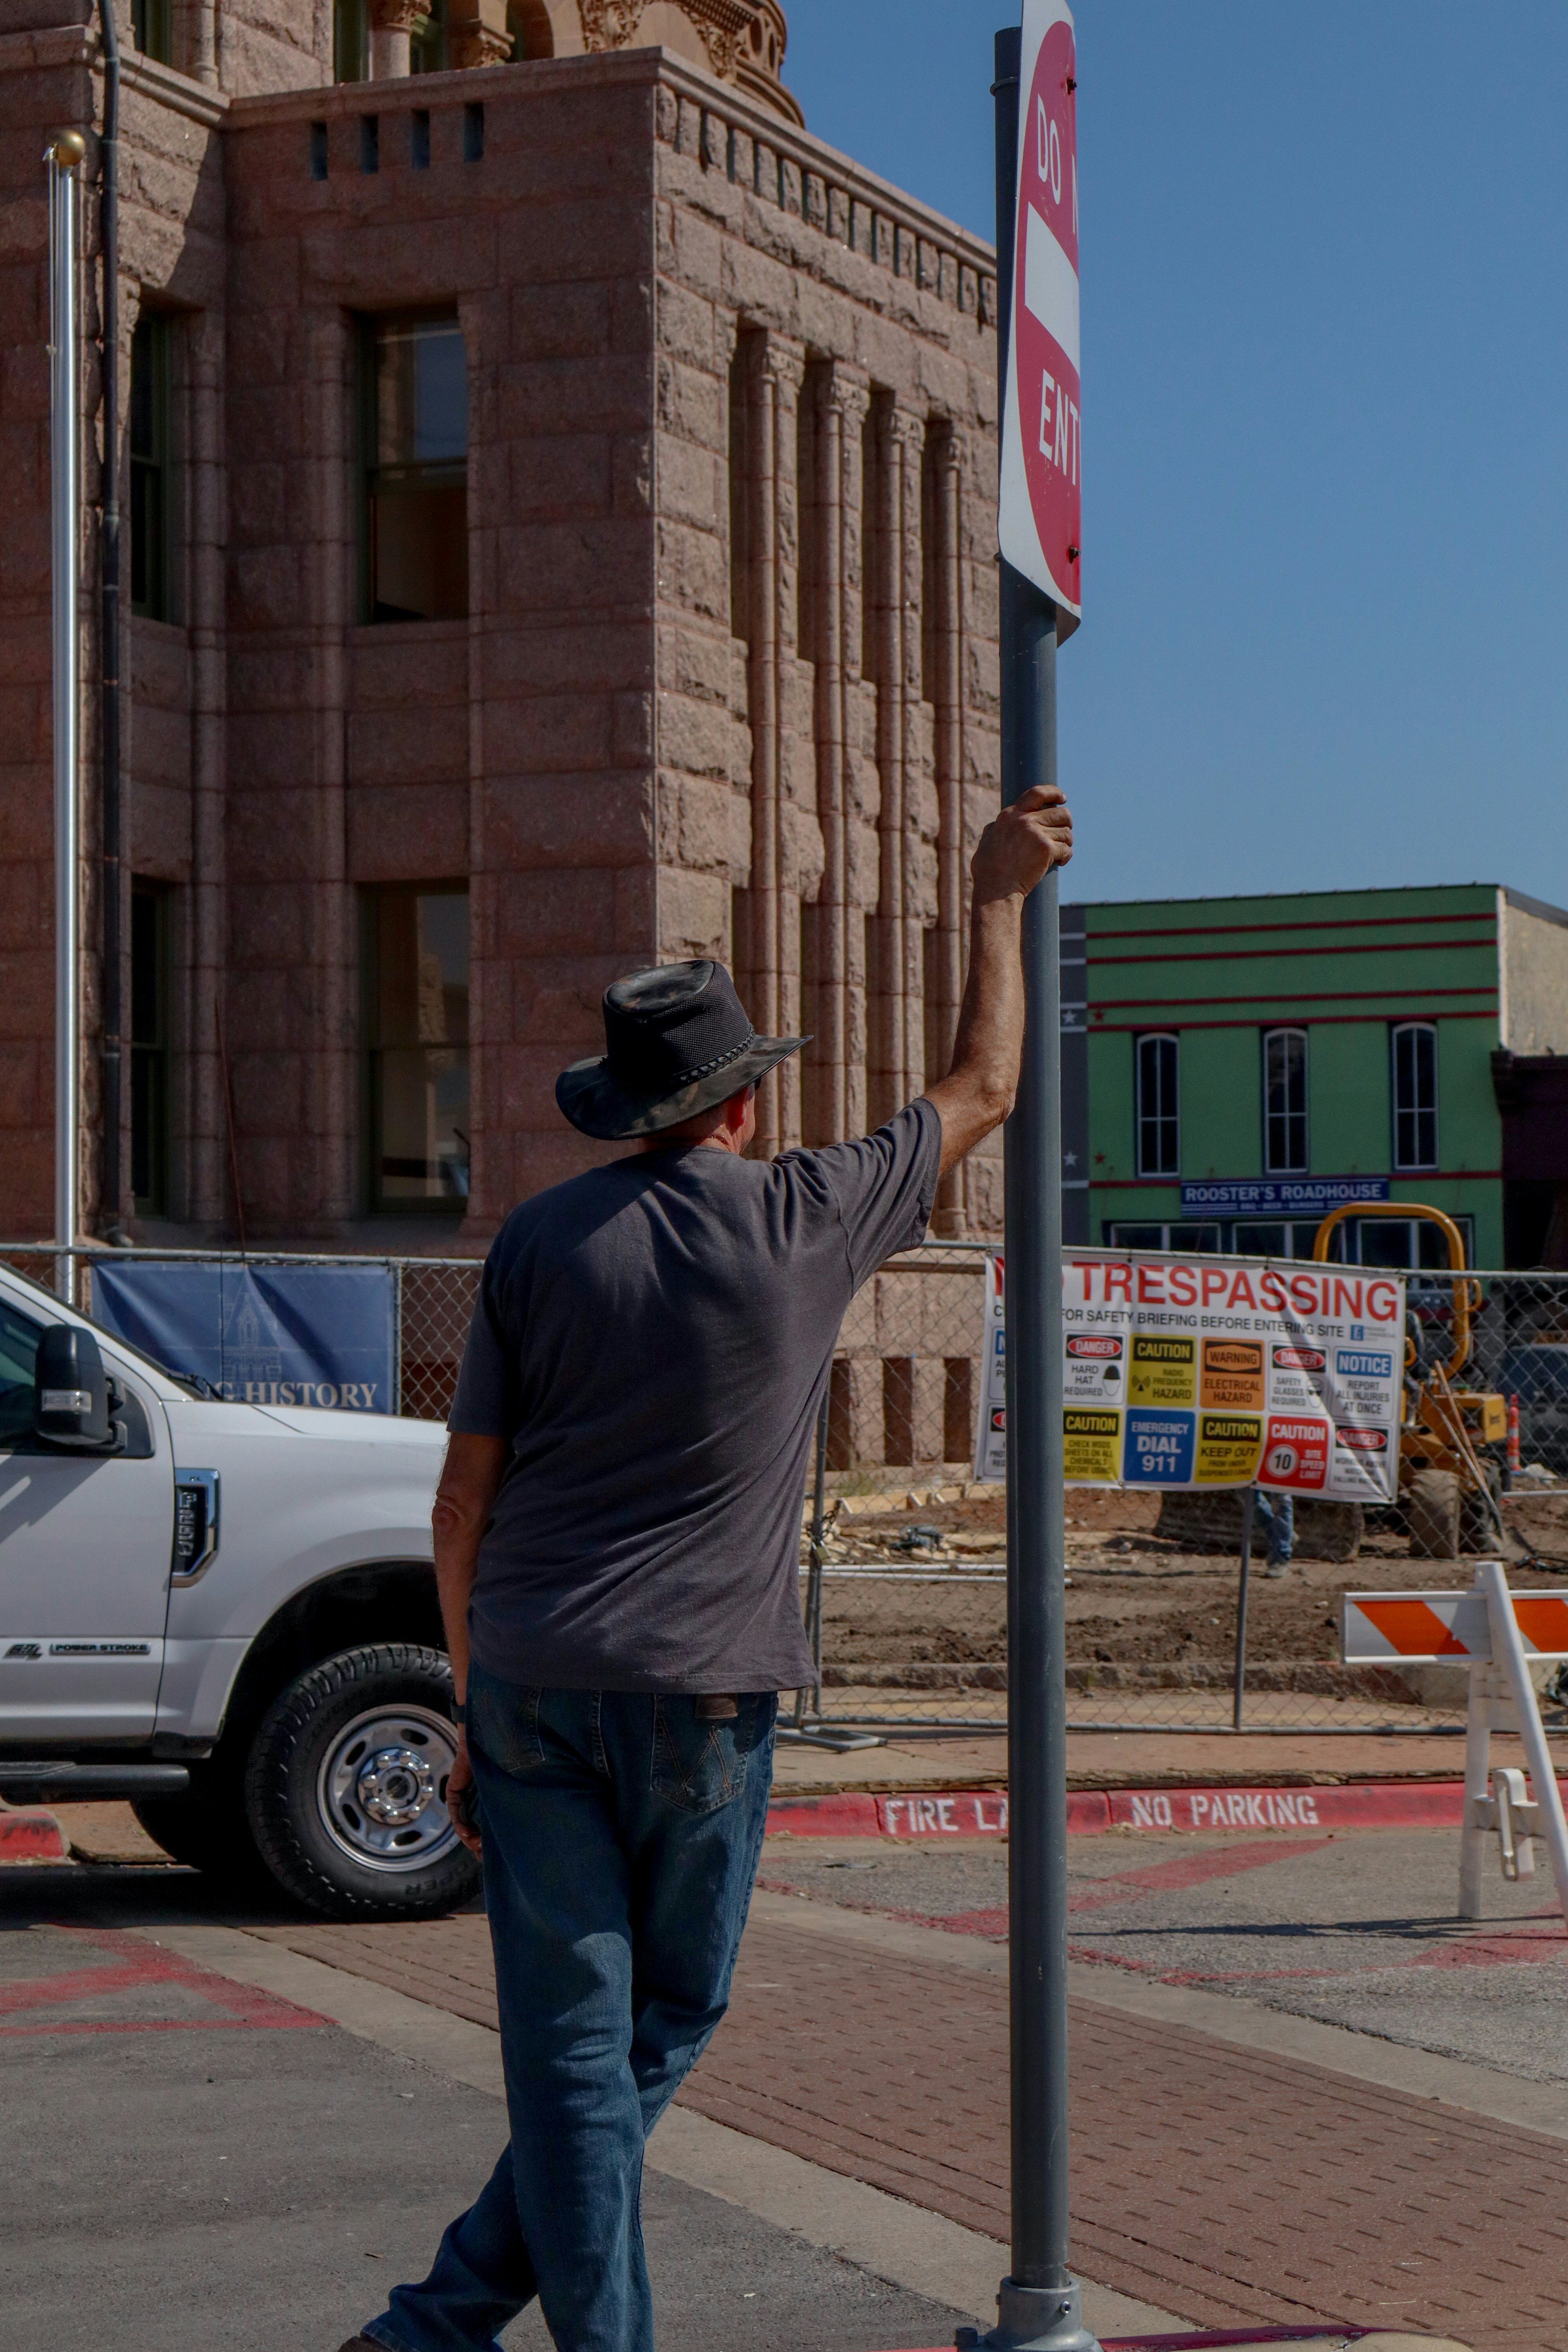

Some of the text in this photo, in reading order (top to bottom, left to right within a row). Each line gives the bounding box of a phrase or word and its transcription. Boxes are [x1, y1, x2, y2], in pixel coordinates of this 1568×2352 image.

[1038, 93, 1061, 205] DO
[1039, 368, 1080, 486] ENT
[1185, 1184, 1382, 1201] ROOSTER'S ROADHOUSE
[1072, 1261, 1397, 1321] TRESPASSING
[1087, 1310, 1134, 1323] SAFETY
[1138, 1312, 1197, 1326] BRIEFING
[1201, 1316, 1250, 1330] BEFORE
[1255, 1319, 1314, 1335] ENTERING
[1318, 1324, 1344, 1337] SITE
[1075, 1340, 1114, 1354] DANGER
[1137, 1342, 1190, 1358] CAUTION
[1210, 1351, 1257, 1365] WARNING
[1339, 1354, 1389, 1374] NOTICE
[1071, 1365, 1098, 1374] HARD
[1075, 1376, 1094, 1384] HAT
[1205, 1378, 1261, 1391] ELECTRICAL
[1276, 1376, 1301, 1385] SAFETY
[1348, 1380, 1380, 1390] REPORT
[245, 1381, 377, 1408] HISTORY
[1064, 1386, 1103, 1396] REQUIRED
[1153, 1388, 1191, 1399] HAZARD
[1214, 1391, 1252, 1402] HAZARD
[1274, 1387, 1305, 1396] GLASSES
[1337, 1390, 1390, 1402] ALL INJURIES
[1272, 1397, 1307, 1406] REQUIRED
[1343, 1402, 1381, 1414] AT ONCE
[1066, 1416, 1116, 1432] CAUTION
[1132, 1421, 1189, 1435] EMERGENCY
[1206, 1421, 1258, 1437] CAUTION
[1271, 1423, 1325, 1441] CAUTION
[1137, 1435, 1181, 1454] DIAL
[1201, 1446, 1257, 1457] KEEP OUT
[1142, 1455, 1176, 1472] 911
[1275, 1454, 1291, 1470] 10
[886, 1798, 1009, 1834] FIRE LA
[1131, 1795, 1319, 1827] NO PARKING
